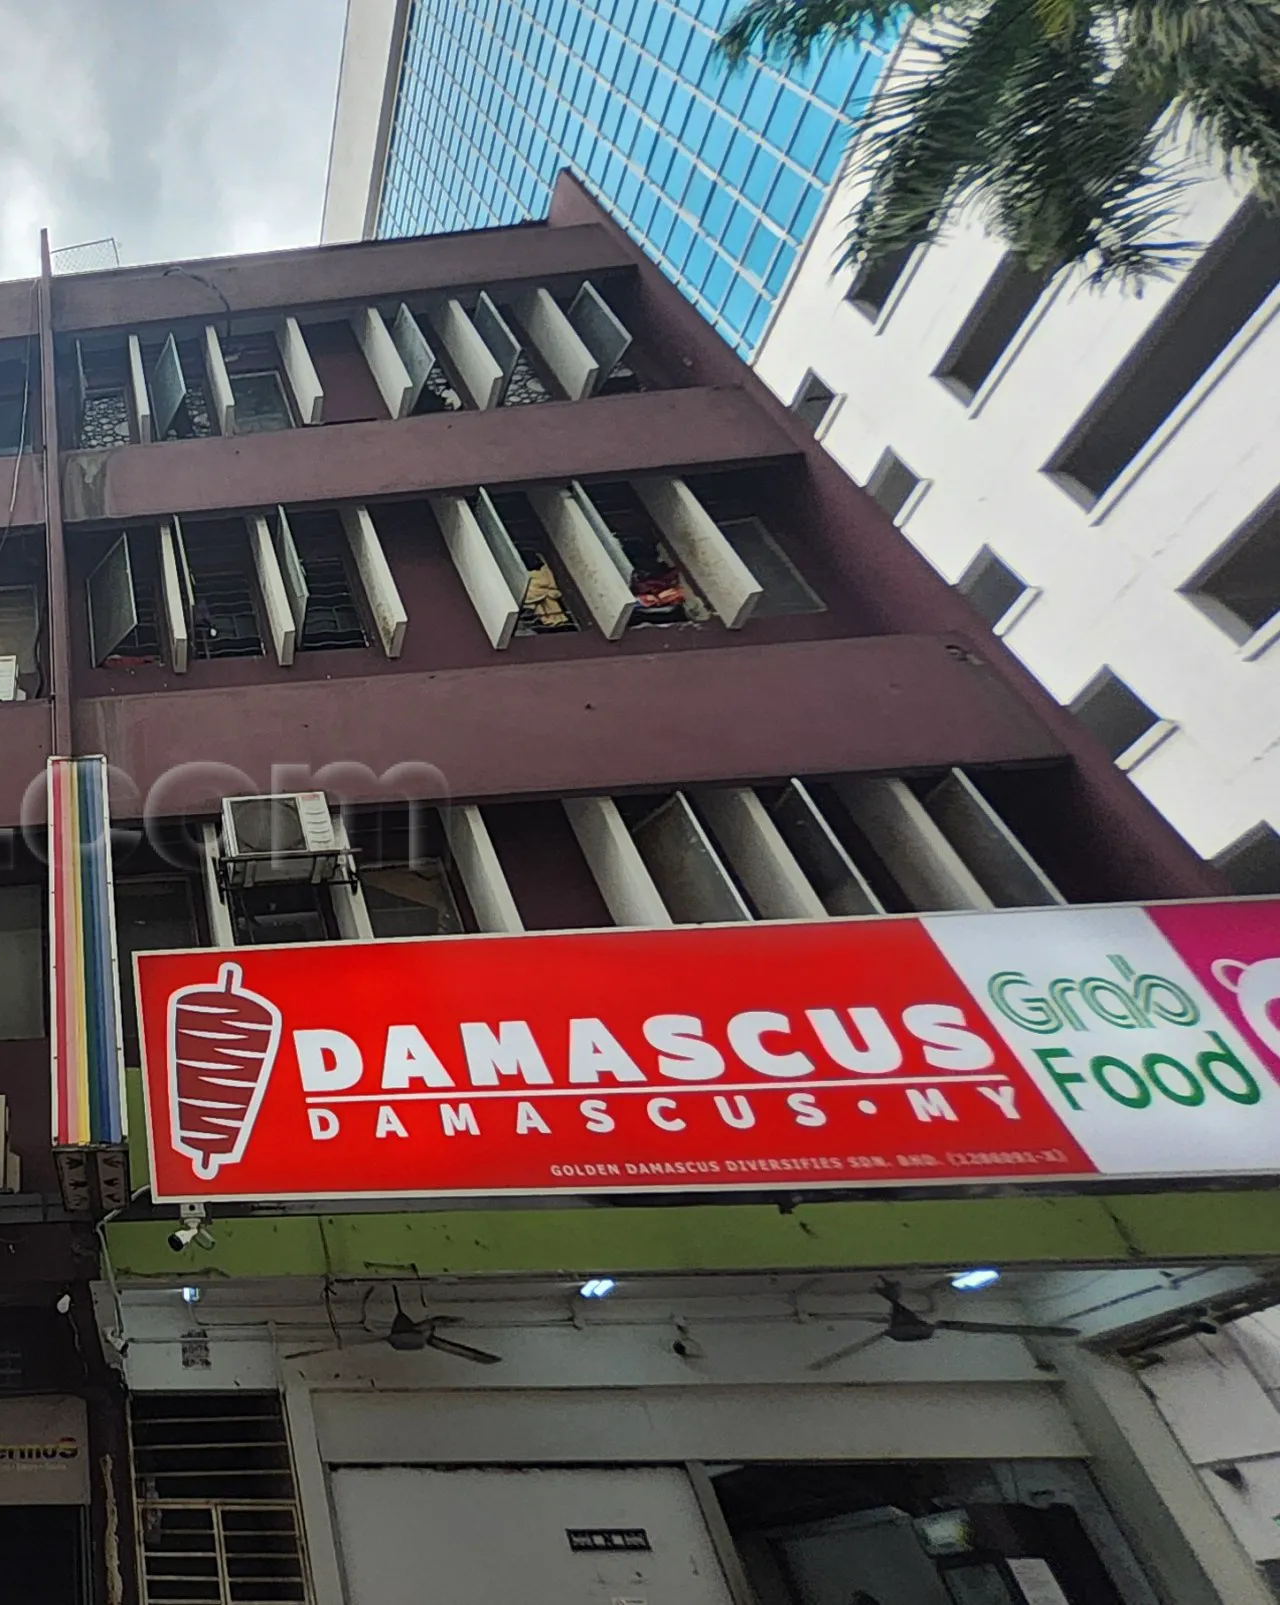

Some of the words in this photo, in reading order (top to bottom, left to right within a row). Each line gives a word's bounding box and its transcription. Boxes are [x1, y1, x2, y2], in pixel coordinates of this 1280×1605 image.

[986, 953, 1201, 1034] Grab
[293, 1004, 995, 1092] DAMASCUS
[1031, 1030, 1261, 1112] Food
[550, 1163, 620, 1178] GOLDEN
[625, 1161, 720, 1177] DAMASCUS
